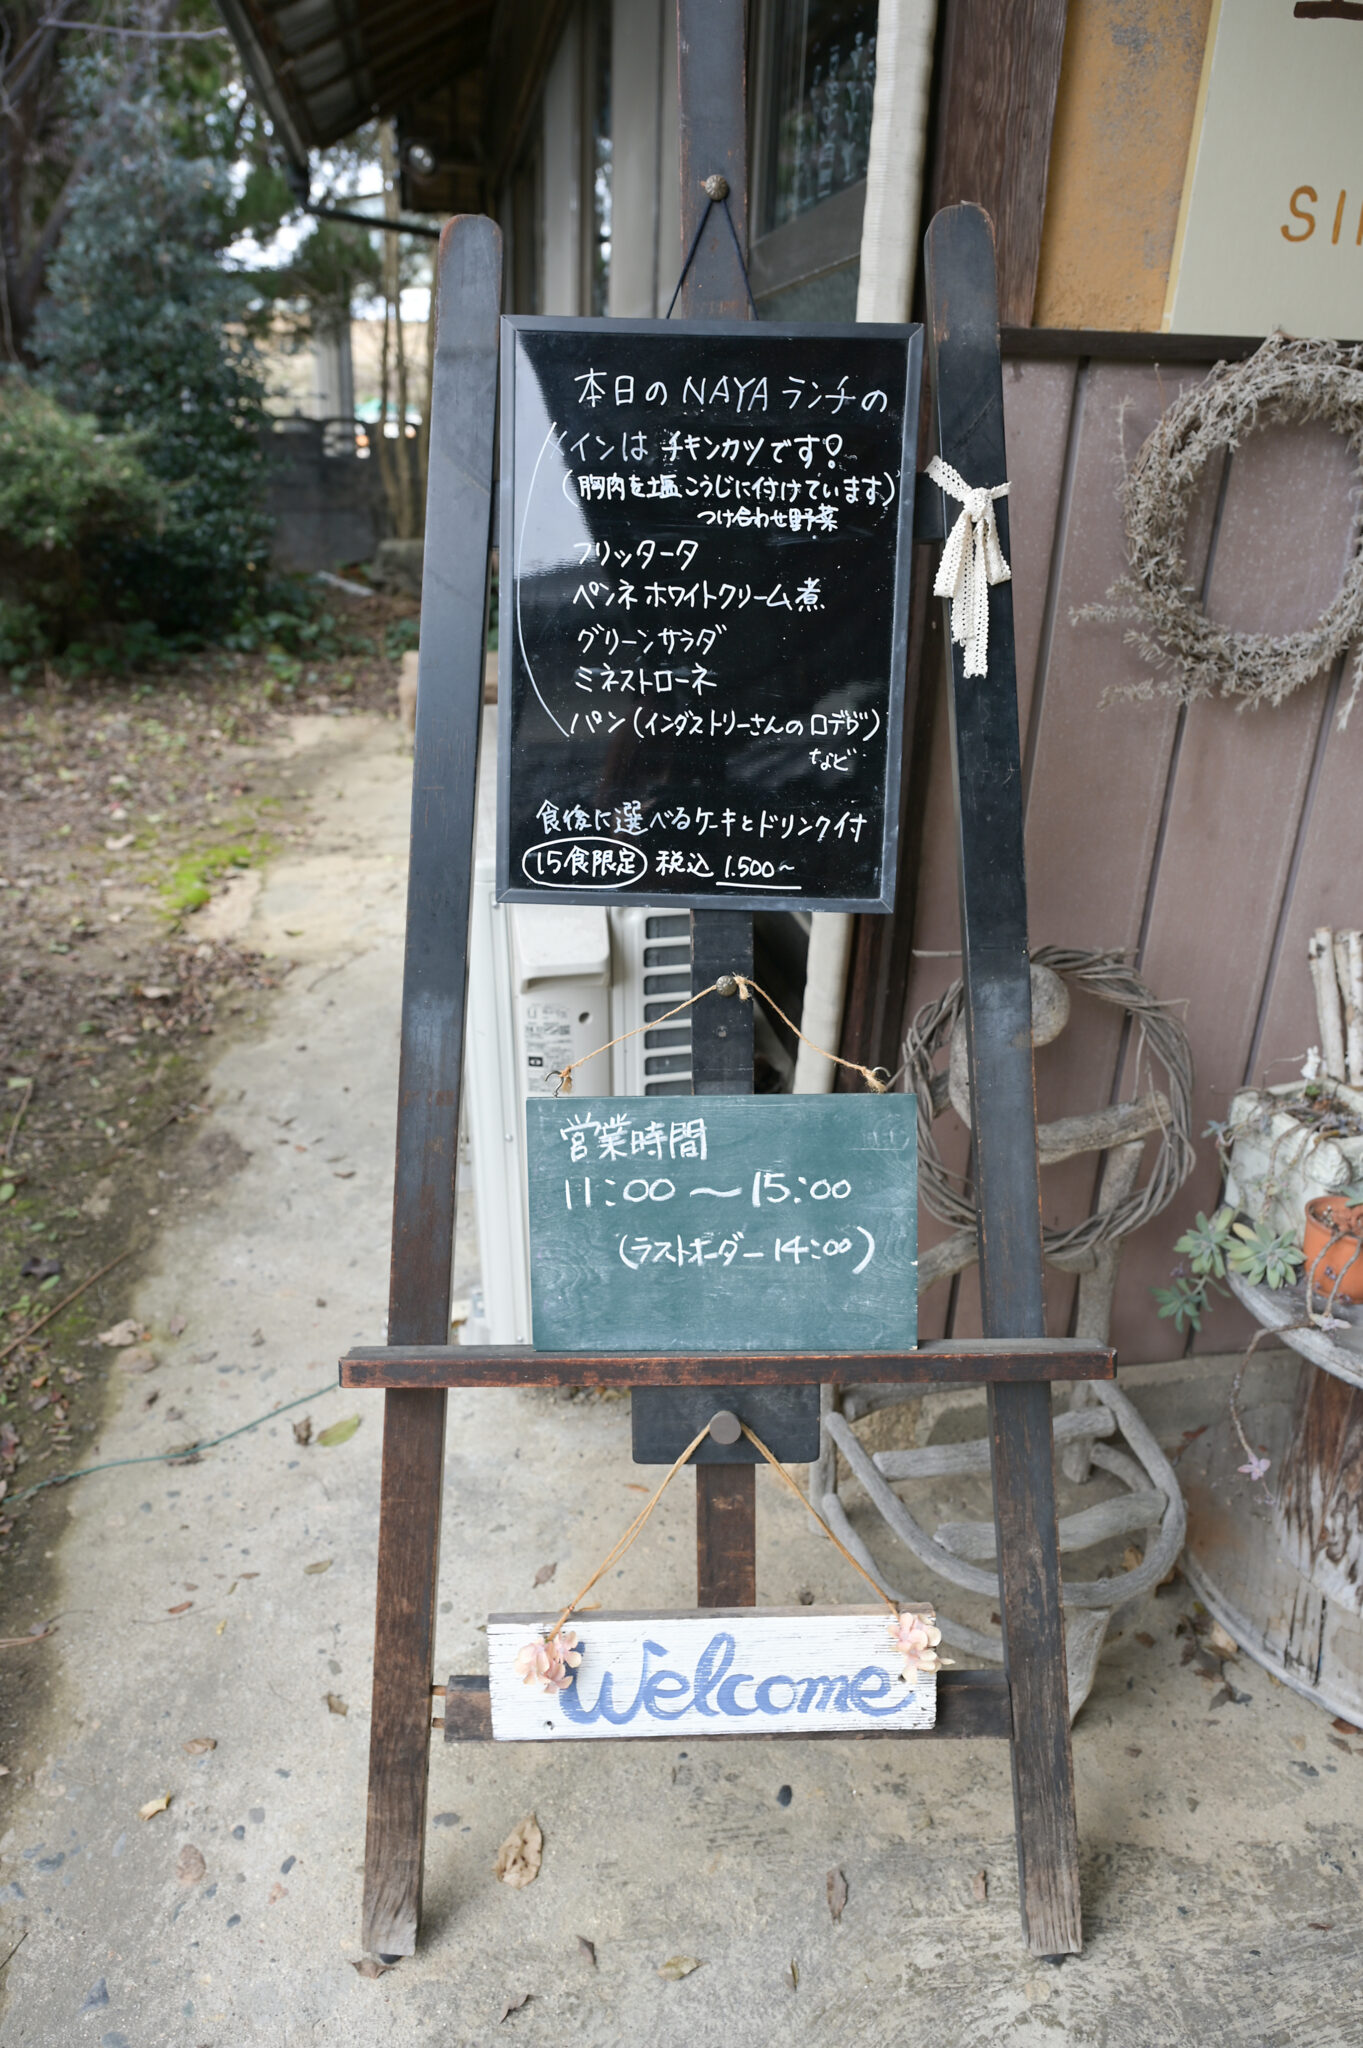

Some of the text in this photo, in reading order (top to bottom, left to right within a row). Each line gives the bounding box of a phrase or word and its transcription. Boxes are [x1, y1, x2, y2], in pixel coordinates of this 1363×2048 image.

[1280, 185, 1363, 246] SI
[574, 368, 888, 415] 本日の NAYA ランチの
[573, 539, 699, 571] フリッタータ
[577, 624, 728, 656] グリーンサラダ
[574, 662, 718, 696] ミネストローネ
[808, 747, 858, 772] など
[536, 845, 637, 878] 15食限定
[655, 850, 715, 878] 税込
[560, 1112, 708, 1162] 営業時間
[558, 1631, 917, 1725] Welcome
